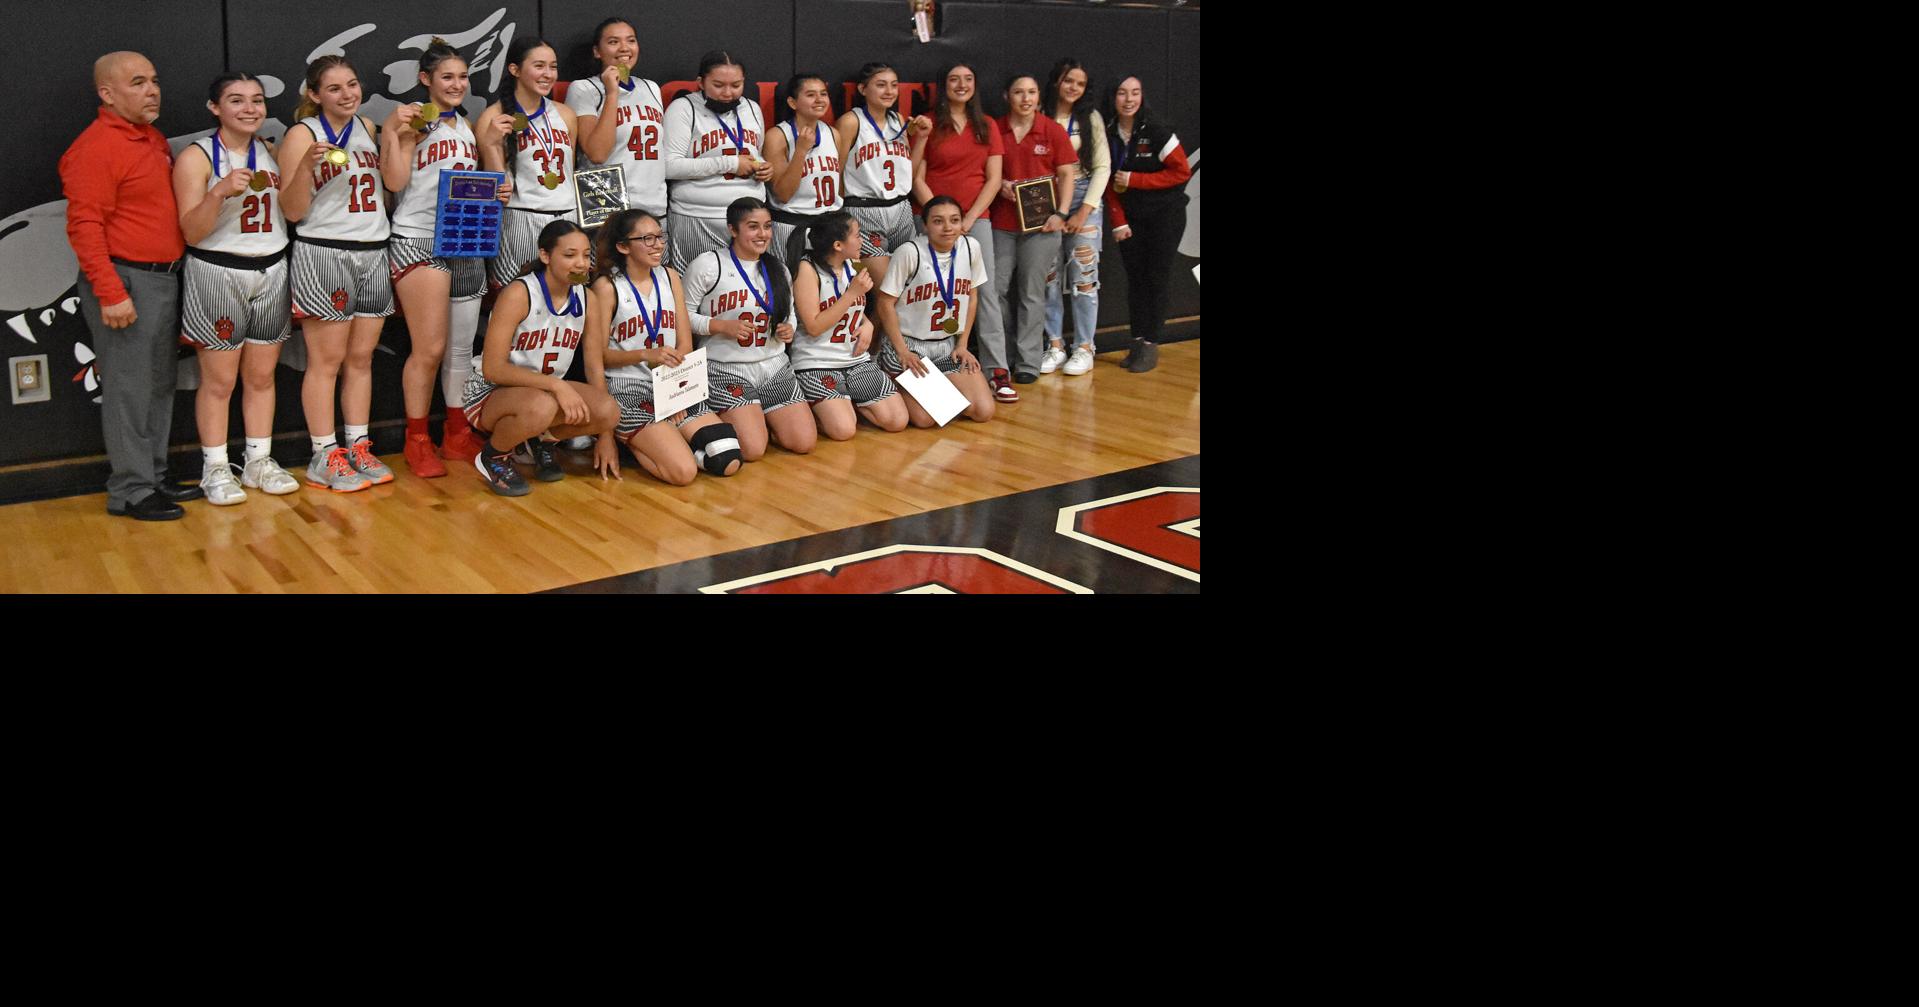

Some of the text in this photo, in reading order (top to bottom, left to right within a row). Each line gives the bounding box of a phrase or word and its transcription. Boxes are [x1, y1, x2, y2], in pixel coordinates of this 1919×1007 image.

[616, 105, 632, 128] DY
[517, 128, 571, 152] DY LOB
[627, 125, 658, 160] 42
[693, 129, 727, 158] LADY
[352, 151, 380, 170] LOB
[417, 139, 457, 171] LADY
[533, 148, 565, 186] 33
[818, 156, 840, 173] LOB
[854, 141, 880, 170] LADY
[883, 160, 895, 191] 3
[349, 173, 376, 213] 12
[813, 176, 835, 208] 10
[240, 193, 272, 233] 21
[710, 289, 748, 317] LADY
[906, 281, 940, 305] LADY
[652, 310, 675, 329] LOB
[930, 299, 960, 332] 23
[542, 352, 559, 375] 5
